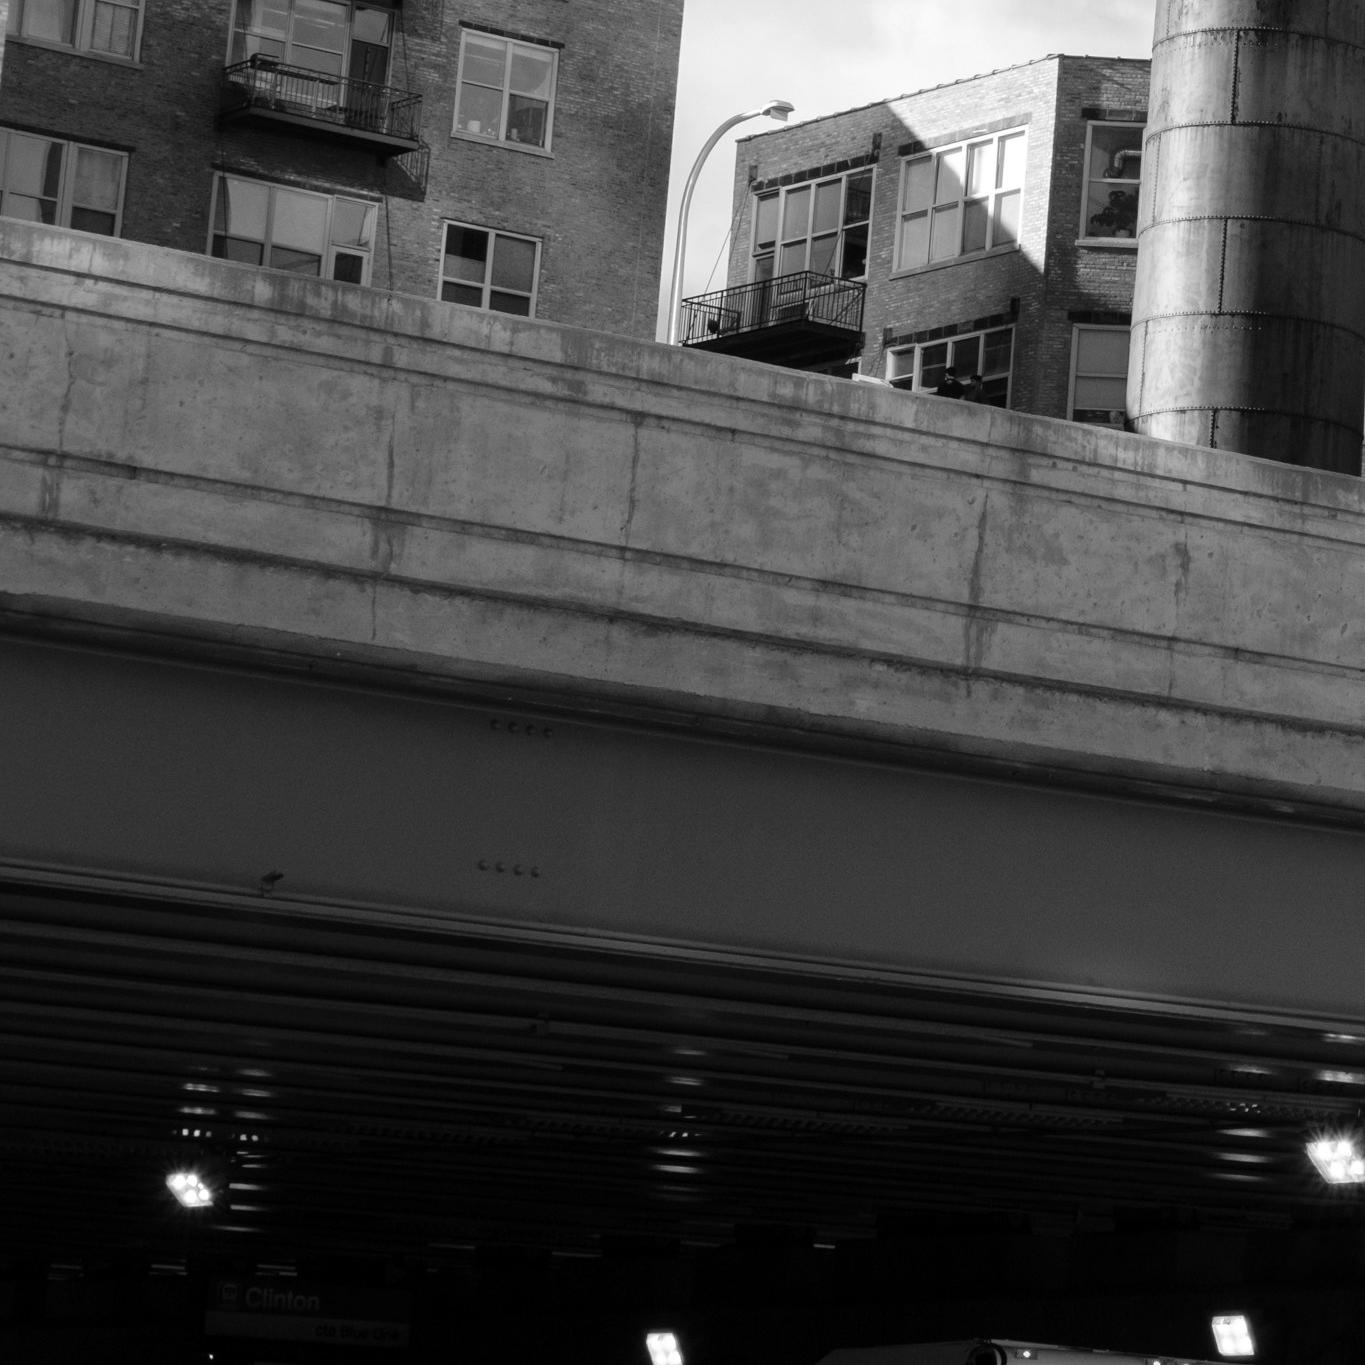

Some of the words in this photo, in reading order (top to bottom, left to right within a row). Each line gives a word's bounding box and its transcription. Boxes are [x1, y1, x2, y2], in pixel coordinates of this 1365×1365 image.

[245, 1286, 320, 1311] Clinton
[315, 1324, 336, 1338] cta
[340, 1325, 369, 1339] Blue
[373, 1327, 400, 1341] Line
